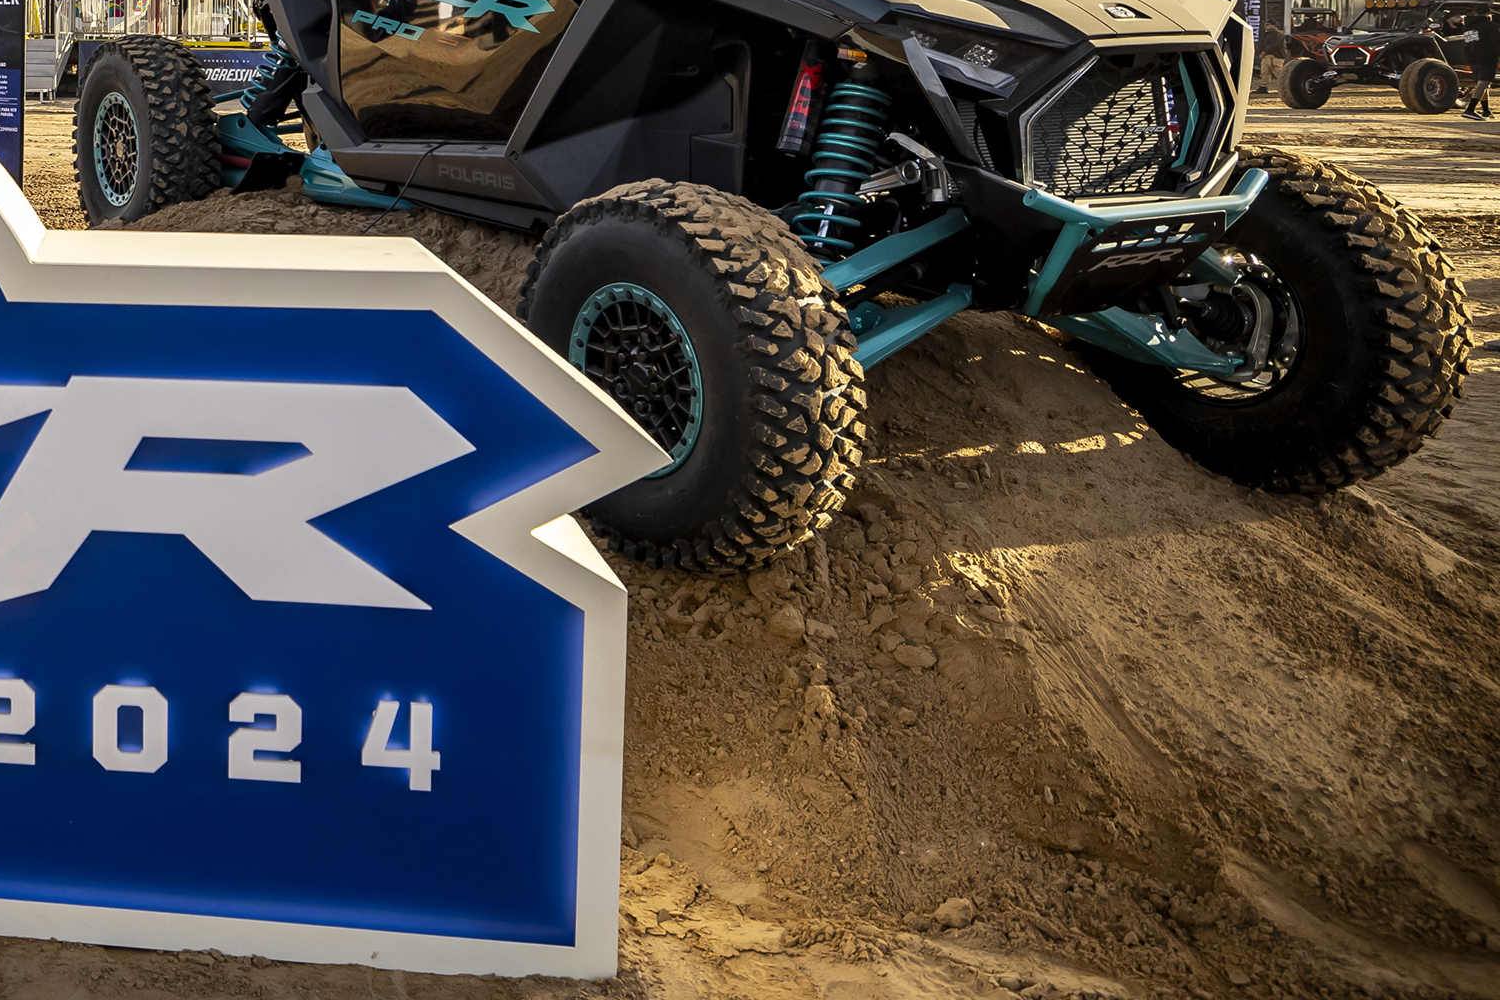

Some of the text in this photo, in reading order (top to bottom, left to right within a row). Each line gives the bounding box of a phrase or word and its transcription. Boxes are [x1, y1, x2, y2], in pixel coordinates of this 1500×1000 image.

[351, 10, 425, 41] PRO
[200, 68, 262, 82] OGRESSIV
[789, 62, 823, 117] FOX
[438, 163, 515, 191] POLARIS
[1088, 248, 1183, 272] RZR
